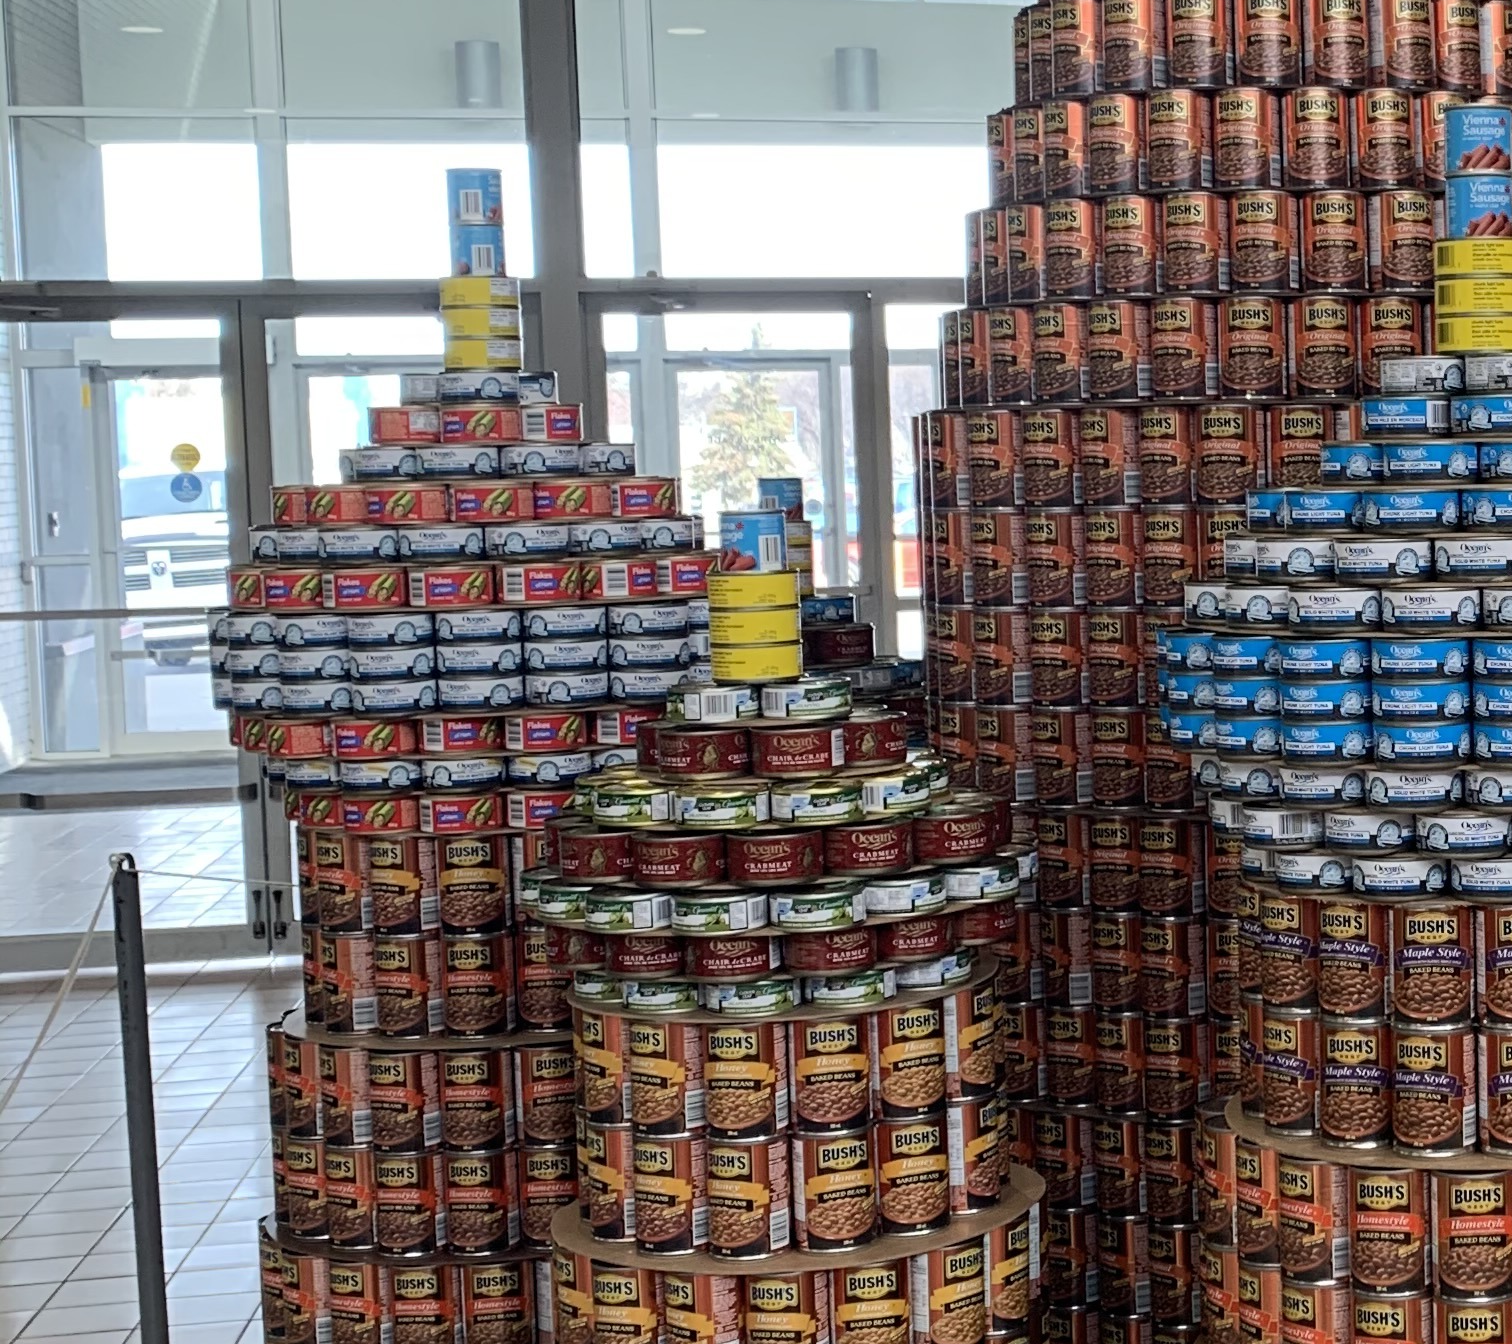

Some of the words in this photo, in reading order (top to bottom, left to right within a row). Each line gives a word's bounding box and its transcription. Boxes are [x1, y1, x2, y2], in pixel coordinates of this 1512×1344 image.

[1299, 99, 1337, 114] BUSH'S
[1463, 115, 1499, 125] Vienna
[1470, 182, 1505, 192] Vienna
[1237, 200, 1273, 217] BUSH'S
[1315, 200, 1354, 217] BUSH'S
[1230, 307, 1270, 323] BUSH'S
[1308, 307, 1346, 323] BUSH'S
[1203, 415, 1241, 431] BUSH'S
[448, 843, 490, 858] BUSH'S
[1408, 917, 1455, 936] BUSH'S
[449, 948, 488, 963] BUSH'S
[1403, 949, 1434, 962] Maple
[1437, 948, 1463, 961] Style
[710, 1035, 754, 1050] BUSH'S
[810, 1028, 855, 1044] BUSH'S
[1328, 1038, 1375, 1055] BUSH'S
[446, 1062, 485, 1078] BUSH'S
[715, 1063, 749, 1075] Honey
[817, 1056, 850, 1068] Honey
[895, 1130, 939, 1147] BUSH'S
[378, 1164, 414, 1181] BUSH'S
[1454, 1187, 1501, 1205] BUSH'S
[1450, 1217, 1506, 1232] Homestyle
[849, 1272, 895, 1289] BUSH'S
[855, 1302, 890, 1314] Honey
